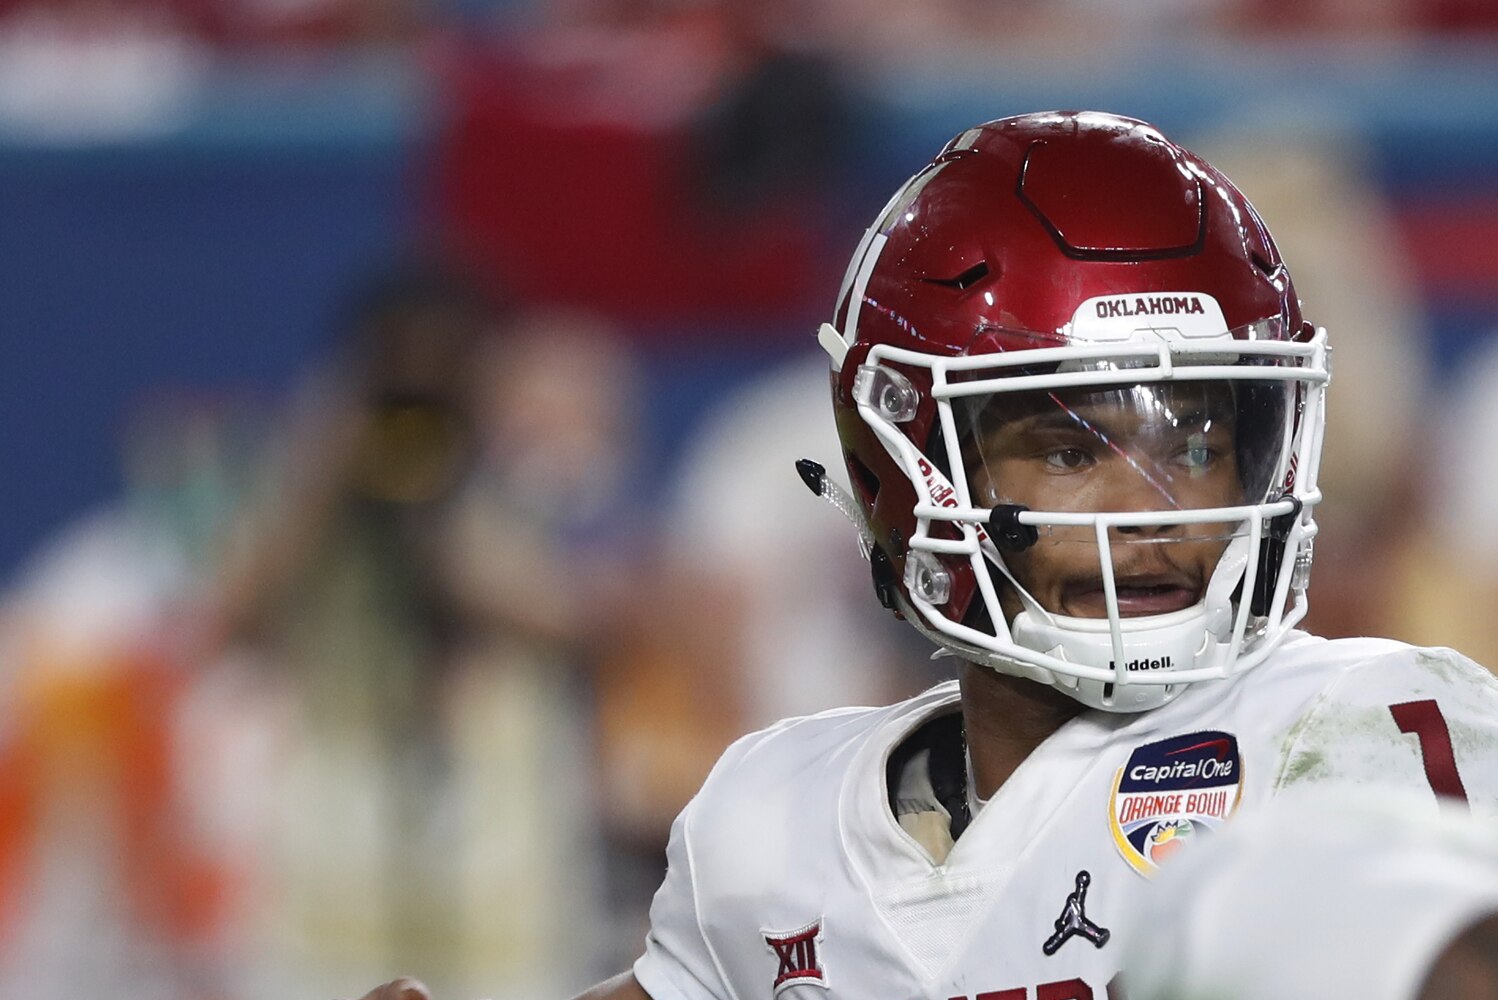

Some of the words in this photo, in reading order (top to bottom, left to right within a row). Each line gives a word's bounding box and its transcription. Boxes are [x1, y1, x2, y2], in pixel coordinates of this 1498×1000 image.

[1096, 297, 1205, 319] OKLAHOMA
[1119, 794, 1183, 824] ORANGE
[1185, 791, 1228, 819] BOWL
[764, 922, 824, 990] XII
